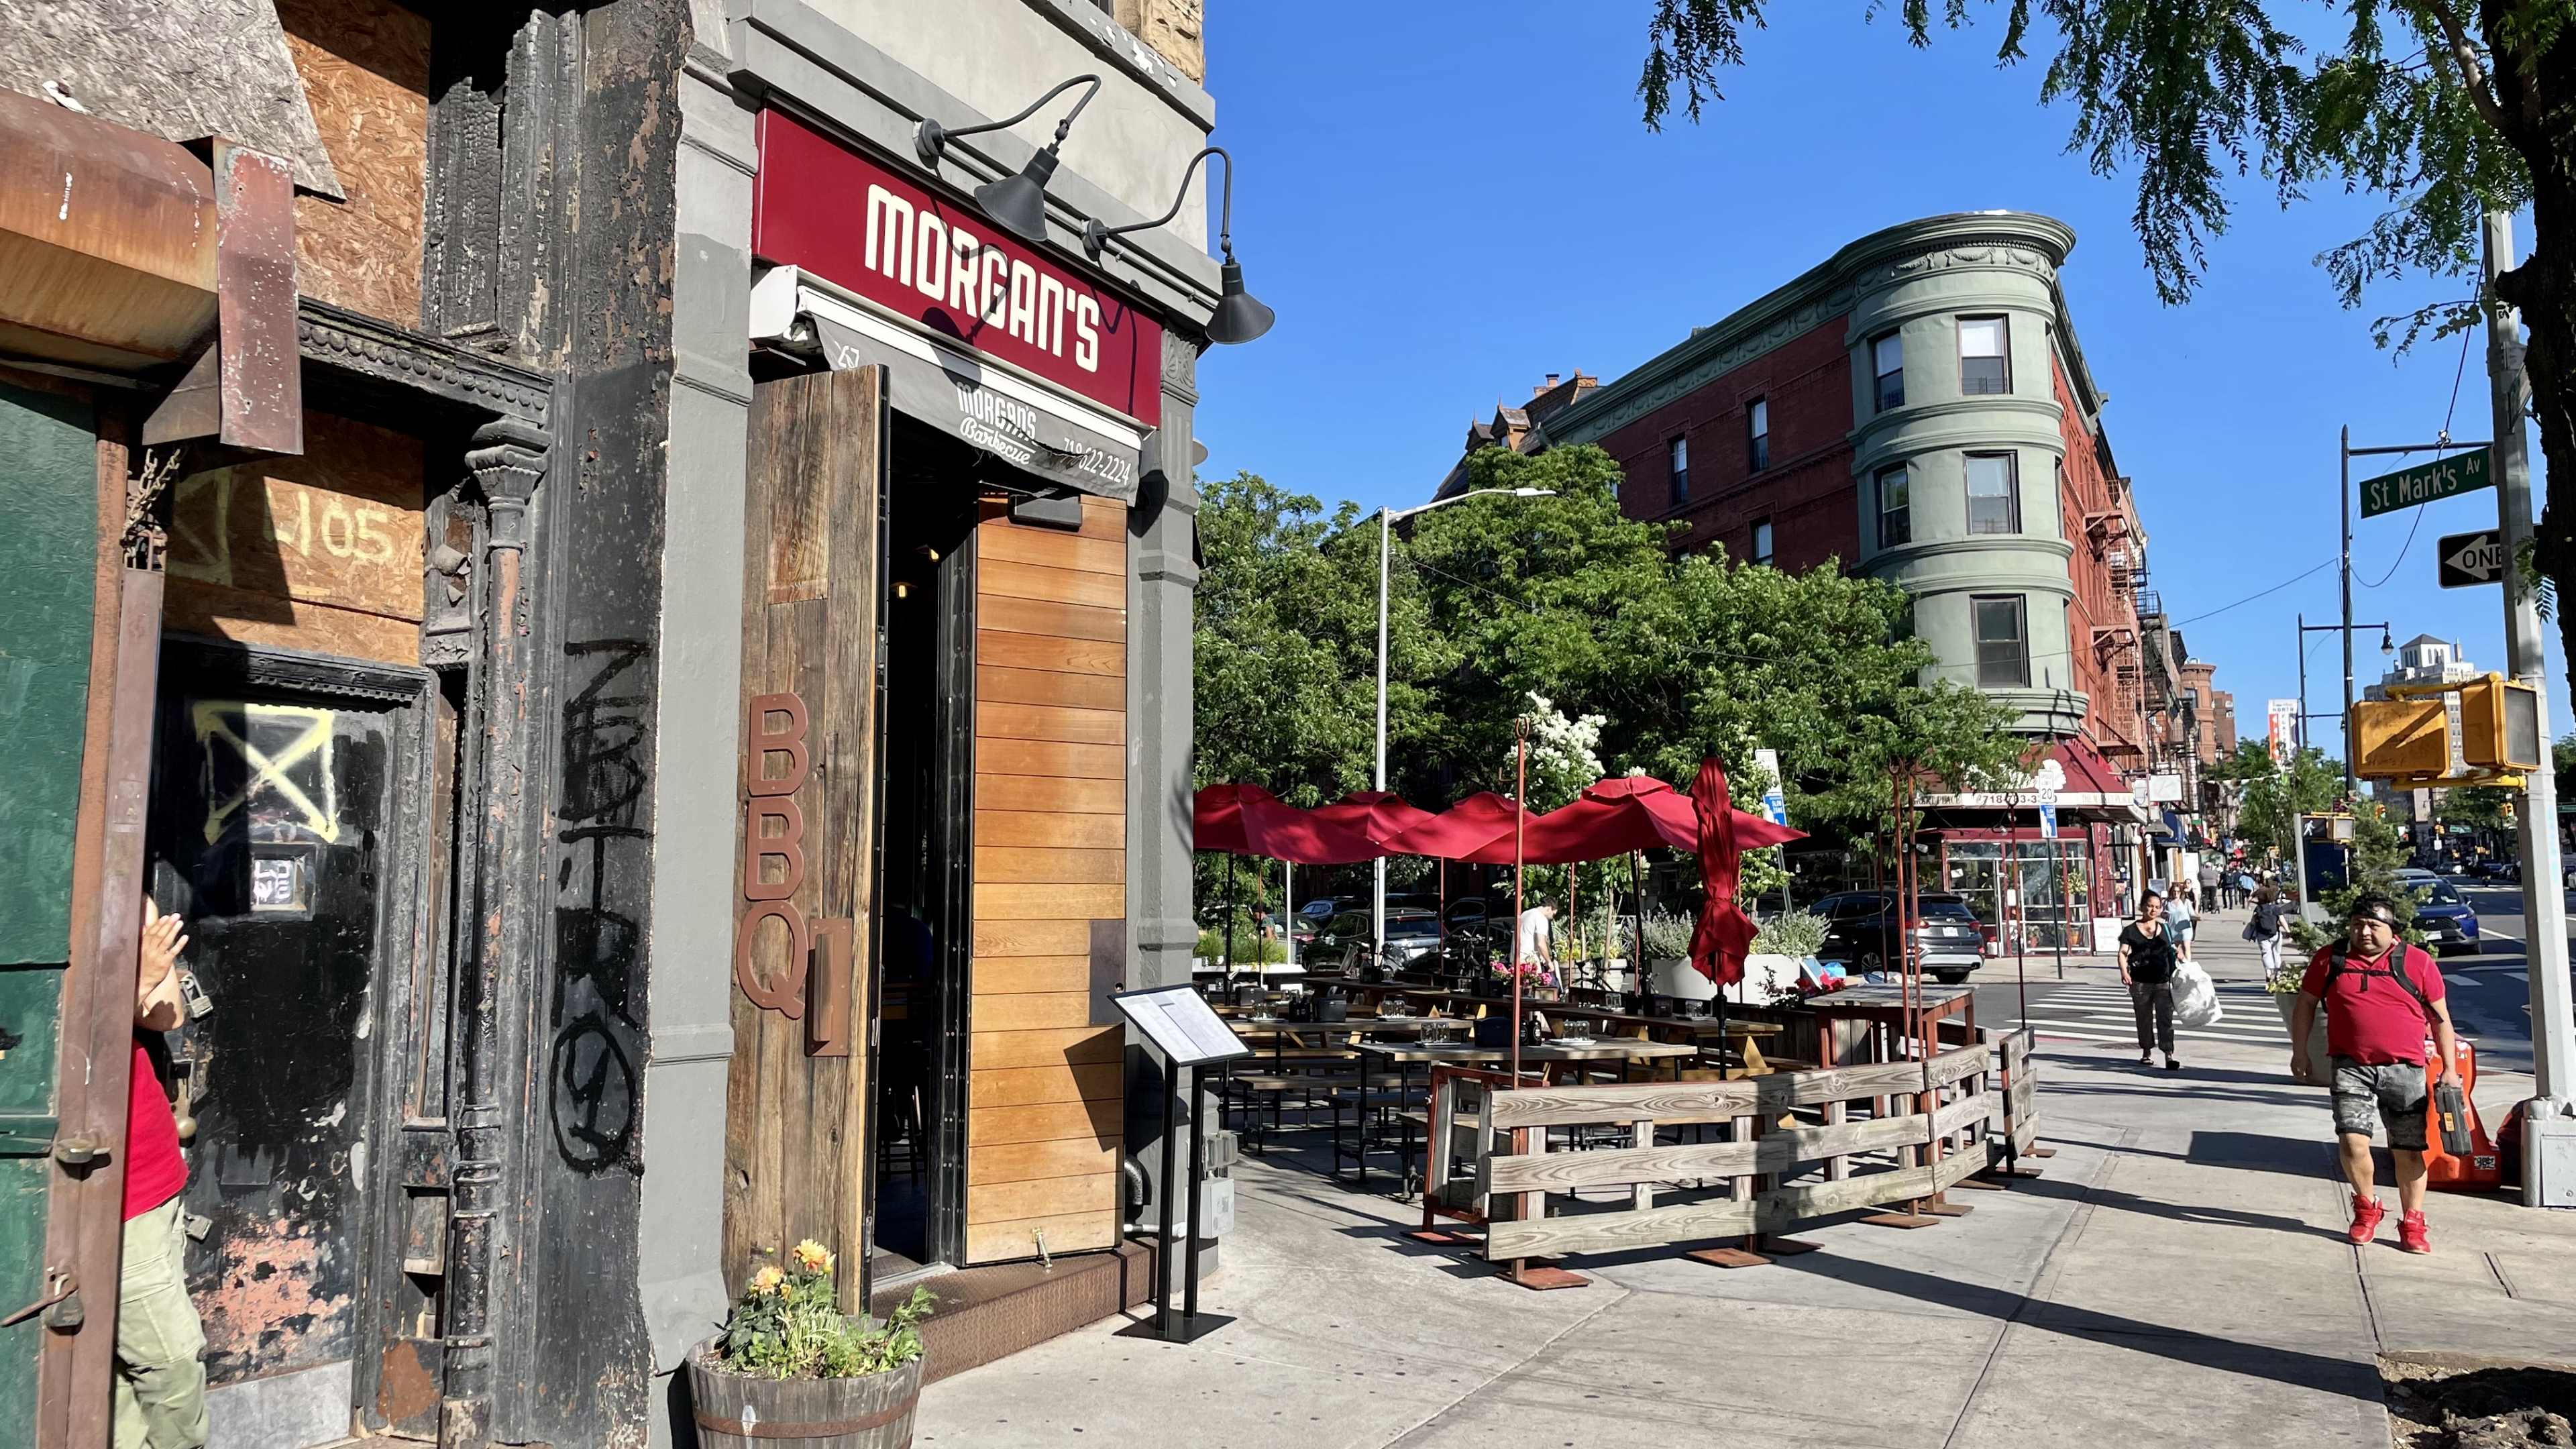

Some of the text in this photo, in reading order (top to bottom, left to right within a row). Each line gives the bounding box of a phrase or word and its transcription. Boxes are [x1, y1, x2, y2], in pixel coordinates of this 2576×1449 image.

[865, 184, 1100, 373] MORGAN'S
[957, 381, 1038, 444] MORGAN'S
[960, 417, 1030, 464] Barbecue
[2370, 458, 2480, 511] St Mark's Av
[2041, 788, 2053, 800] 20
[737, 692, 809, 1020] BBQ
